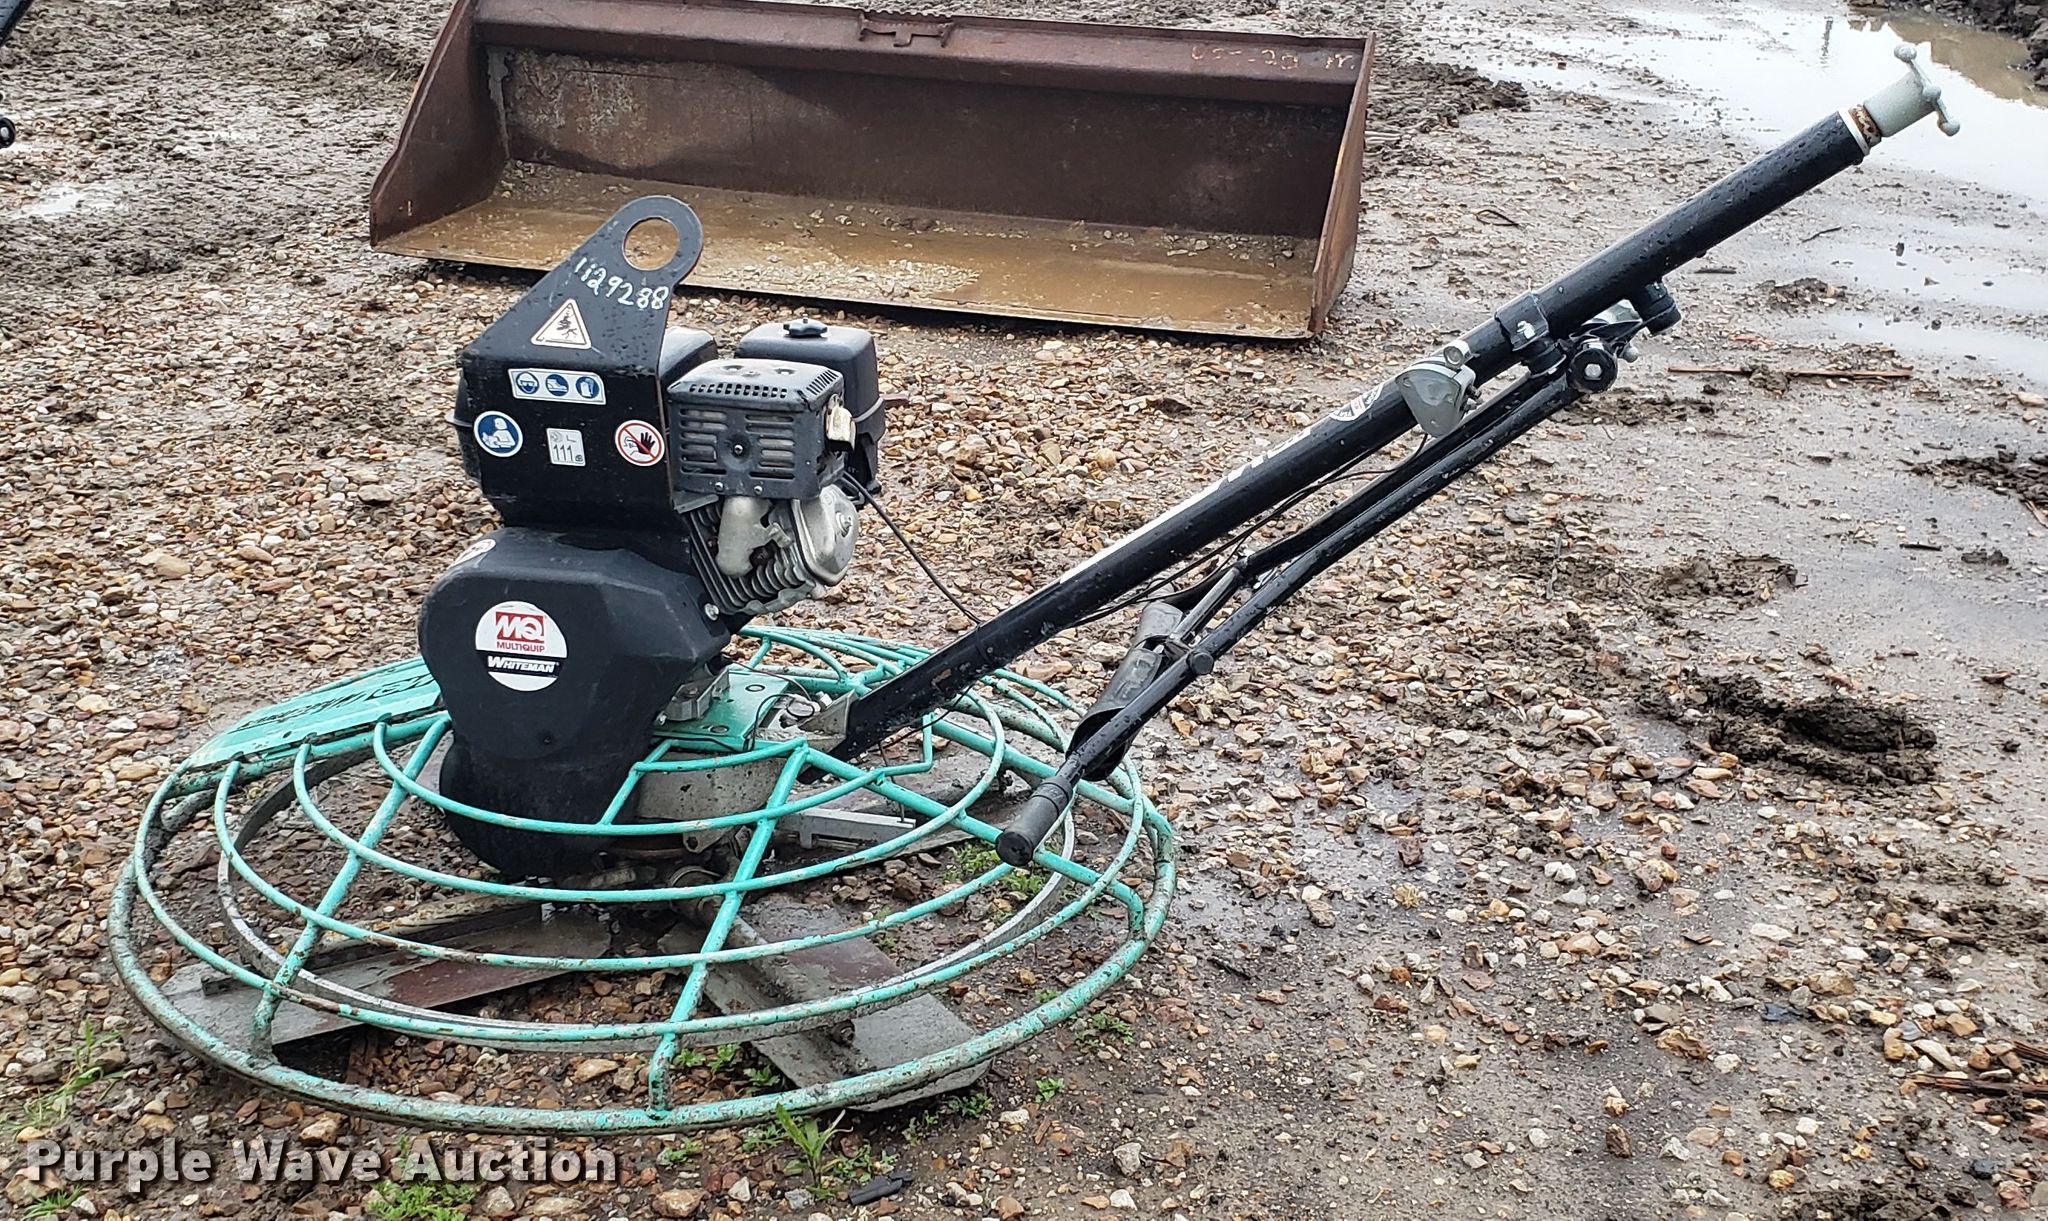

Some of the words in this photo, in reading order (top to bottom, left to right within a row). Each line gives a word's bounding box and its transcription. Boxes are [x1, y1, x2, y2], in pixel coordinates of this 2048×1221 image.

[574, 257, 669, 310] 1129288
[495, 615, 545, 641] MQ
[496, 641, 545, 653] MULTIQUIP
